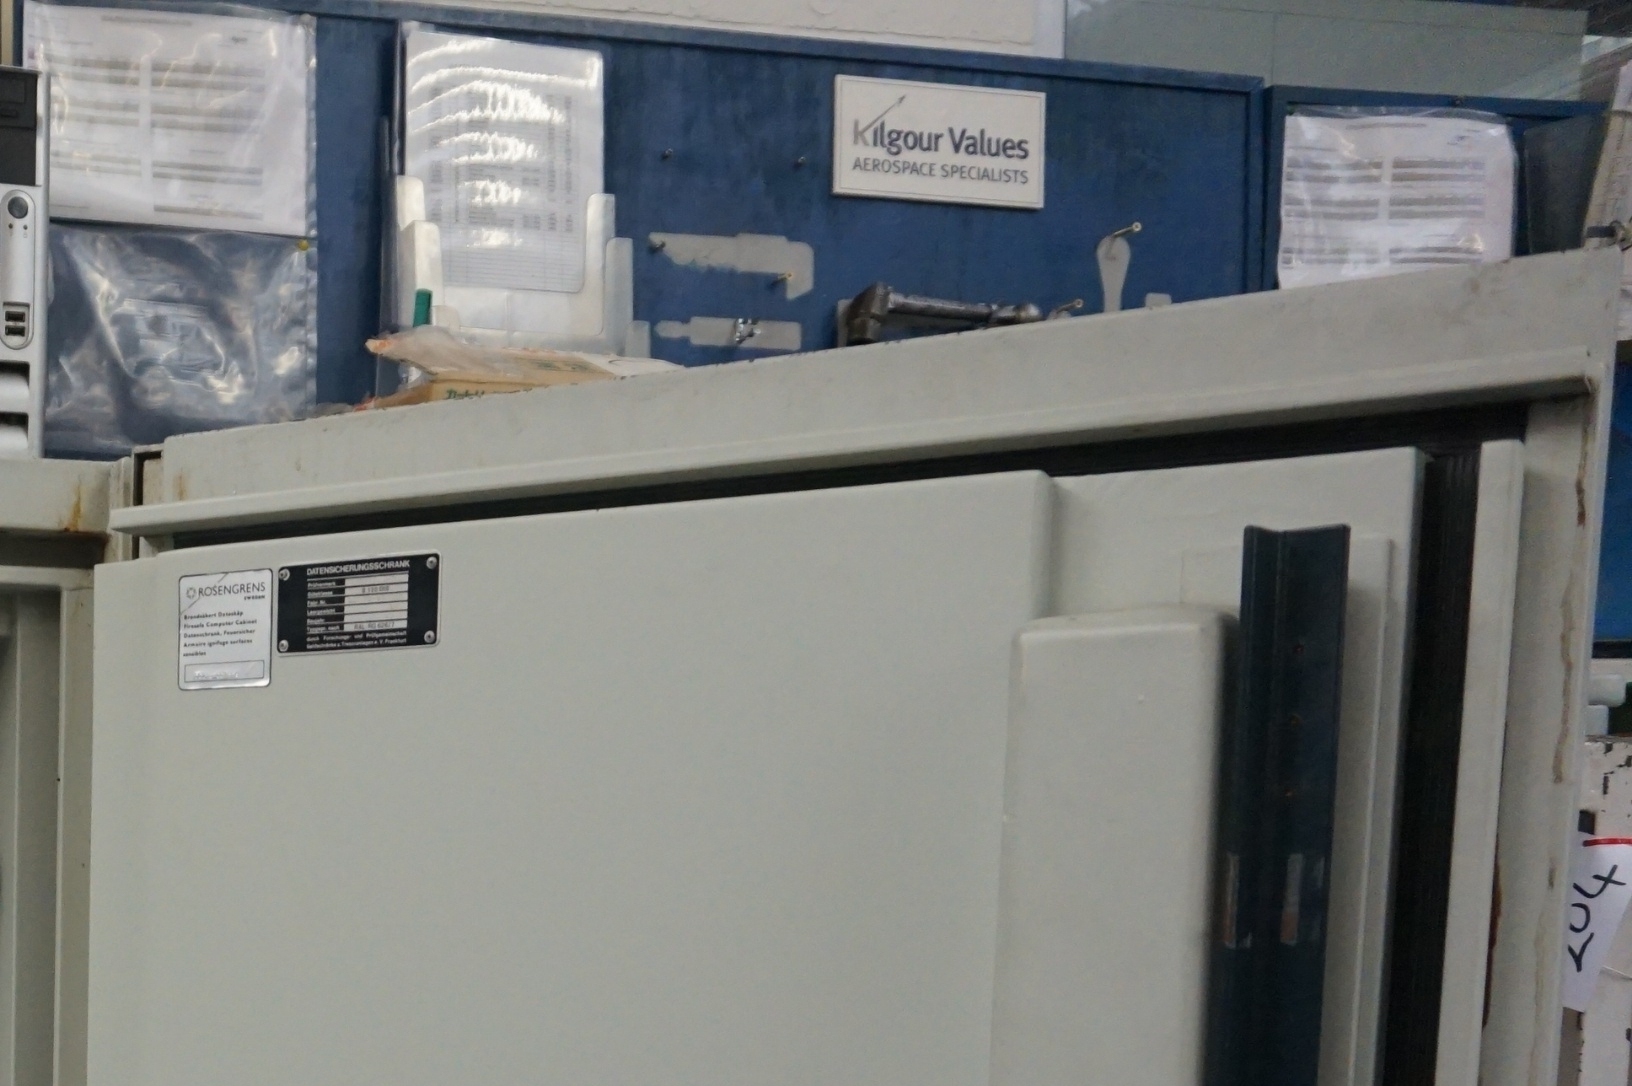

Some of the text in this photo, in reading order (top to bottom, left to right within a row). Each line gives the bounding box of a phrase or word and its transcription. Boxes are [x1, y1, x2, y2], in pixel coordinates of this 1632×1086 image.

[853, 112, 1029, 160] Kilgour Values
[852, 156, 1029, 185] AEROSPACE SPECIALISTS
[306, 559, 411, 576] DATENSICHERUNGSSCHRANK
[198, 581, 266, 597] ROSENGRENS
[206, 620, 234, 628] Computer
